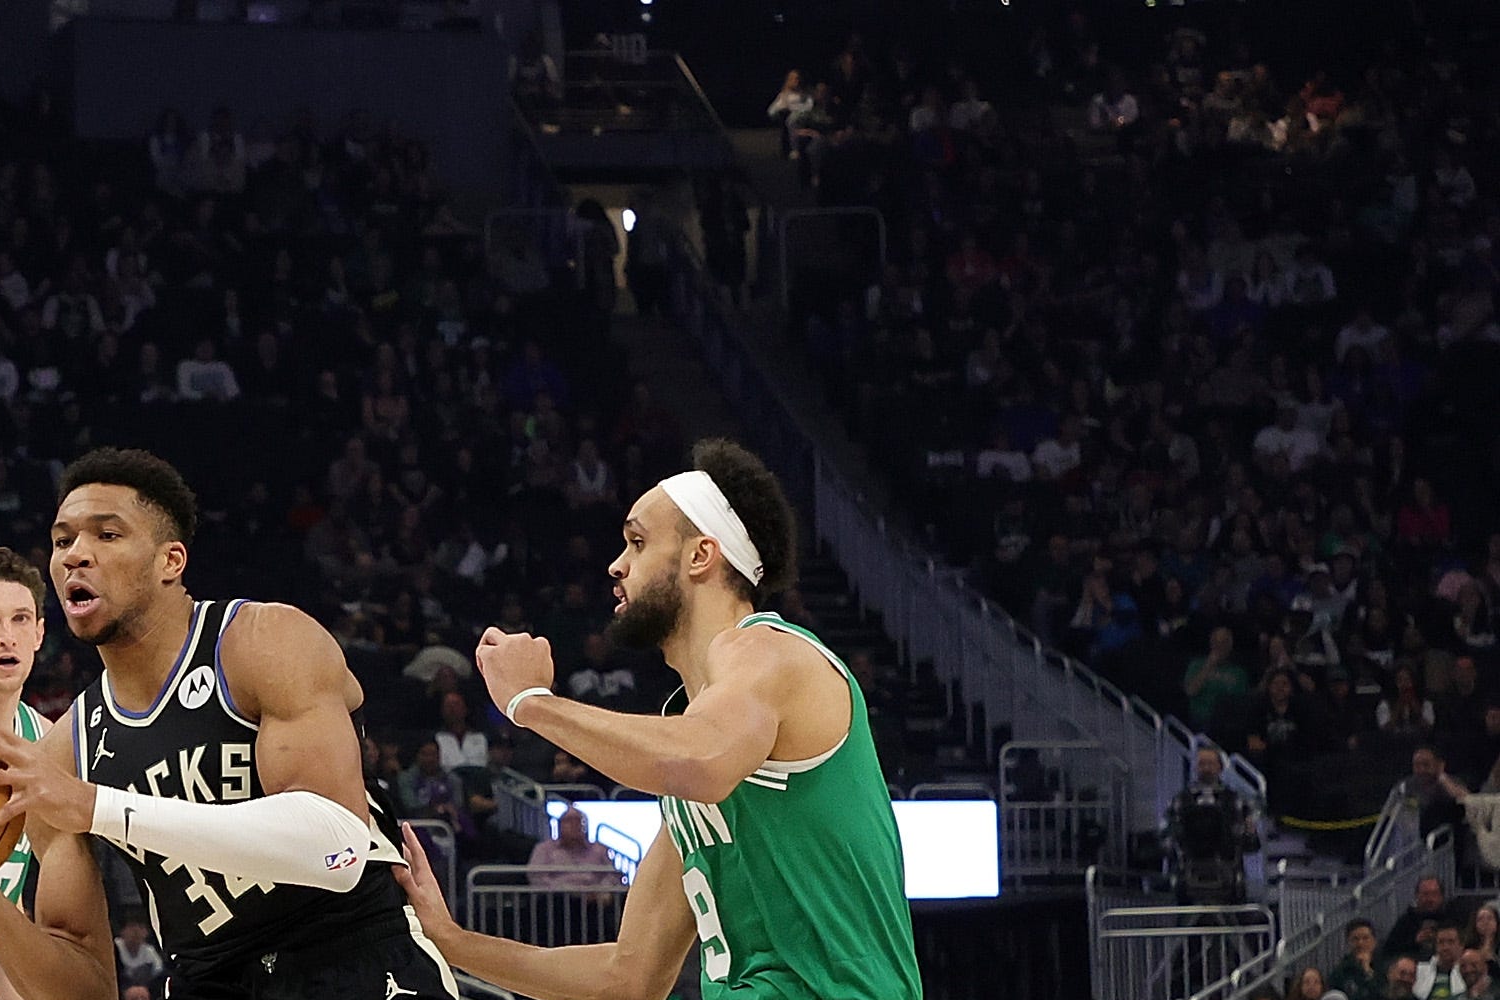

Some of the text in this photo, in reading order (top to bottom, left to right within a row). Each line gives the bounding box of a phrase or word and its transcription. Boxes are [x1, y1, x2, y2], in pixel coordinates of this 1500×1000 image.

[89, 705, 103, 728] 6
[127, 742, 251, 803] CKS
[682, 866, 731, 981] 9
